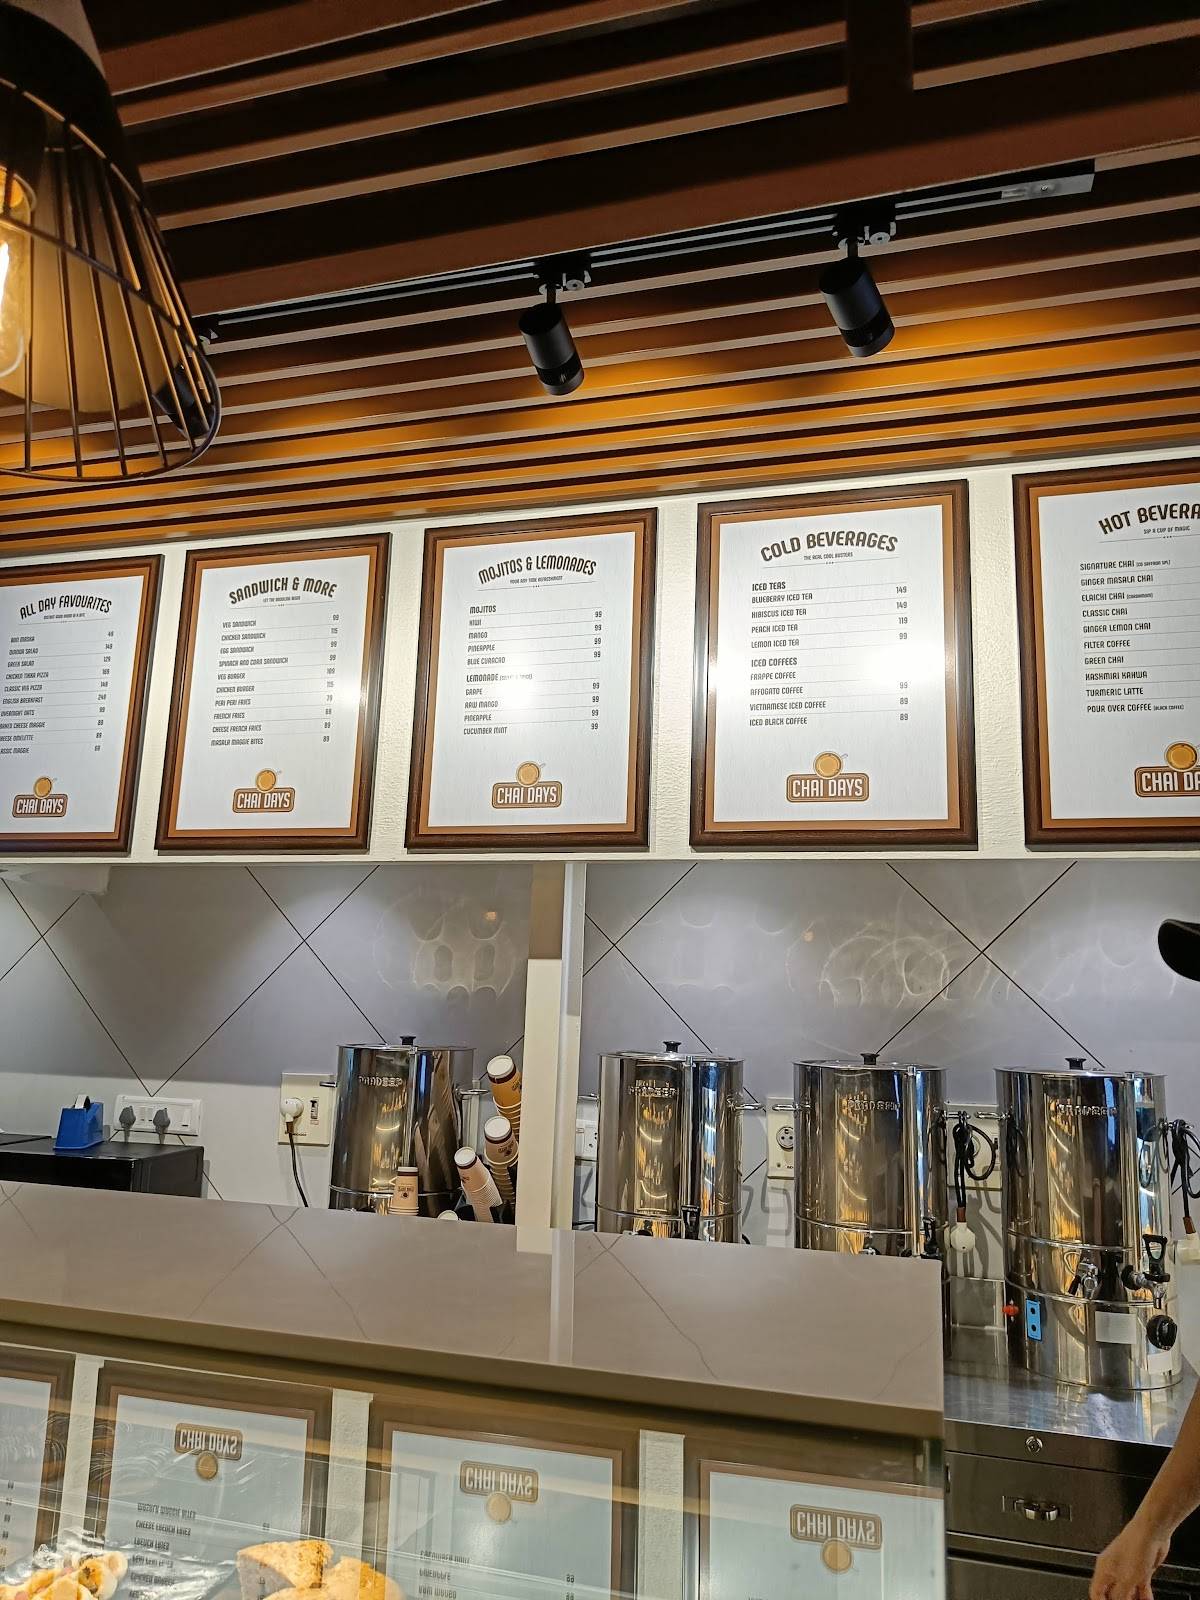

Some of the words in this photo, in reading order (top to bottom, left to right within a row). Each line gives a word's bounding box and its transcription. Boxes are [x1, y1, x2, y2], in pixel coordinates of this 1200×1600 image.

[1098, 510, 1130, 534] HOT
[760, 537, 800, 562] COLD
[806, 530, 898, 552] BEVERAGES
[478, 558, 522, 584] MOJITOS
[526, 556, 532, 570] &
[536, 555, 596, 576] LEMONADES
[1080, 562, 1116, 570] SIGNATURE
[1118, 560, 1134, 568] CHAI
[1080, 578, 1104, 586] GINGER
[1106, 576, 1135, 584] MASALA
[1138, 574, 1154, 582] CHAI
[229, 578, 288, 604] SANDWICH
[292, 577, 300, 590] &
[302, 578, 337, 598] MORE
[752, 584, 767, 592] ICED
[769, 582, 786, 590] TEAS
[752, 595, 785, 604] BLUEBERRY
[896, 586, 907, 594] 149
[1082, 593, 1106, 602] ELAICHI
[1108, 592, 1124, 600] CHAI
[20, 603, 36, 620] ALL
[39, 597, 56, 612] DAY
[59, 595, 112, 613] FAVOURITES
[470, 605, 496, 614] MOJITOS
[896, 601, 908, 609] 149
[1082, 609, 1110, 617] CLASSIC
[787, 624, 798, 632] TEA
[898, 616, 908, 624] 119
[1083, 625, 1107, 633] GINGER
[1110, 624, 1132, 632] LEMON
[1134, 622, 1151, 630] CHAI
[1084, 641, 1105, 649] FILTER
[1106, 640, 1130, 648] COFFEE
[751, 659, 766, 668] ICED
[769, 657, 798, 666] COFFEES
[1084, 656, 1106, 664] GREEN
[466, 674, 498, 682] LEMONADE
[774, 672, 796, 680] COFFEE
[1086, 672, 1120, 680] KASHMIRI
[1122, 671, 1148, 679] KAHWA
[1086, 688, 1121, 696] TURMERIC
[1124, 688, 1144, 696] LATTE
[750, 702, 788, 711] VIETNAMESE
[804, 700, 826, 708] COFFEE
[464, 714, 492, 722] PINEAPPLE
[786, 716, 808, 724] COFFEE
[1142, 772, 1178, 792] CHAI
[792, 779, 823, 798] CHAI
[829, 778, 863, 797] DAYS
[238, 793, 260, 809] CHAI
[264, 792, 290, 808] DAYS
[497, 787, 523, 804] CHAI
[528, 786, 557, 804] DAYS
[16, 798, 38, 814] CHAI
[40, 798, 63, 813] DAYS
